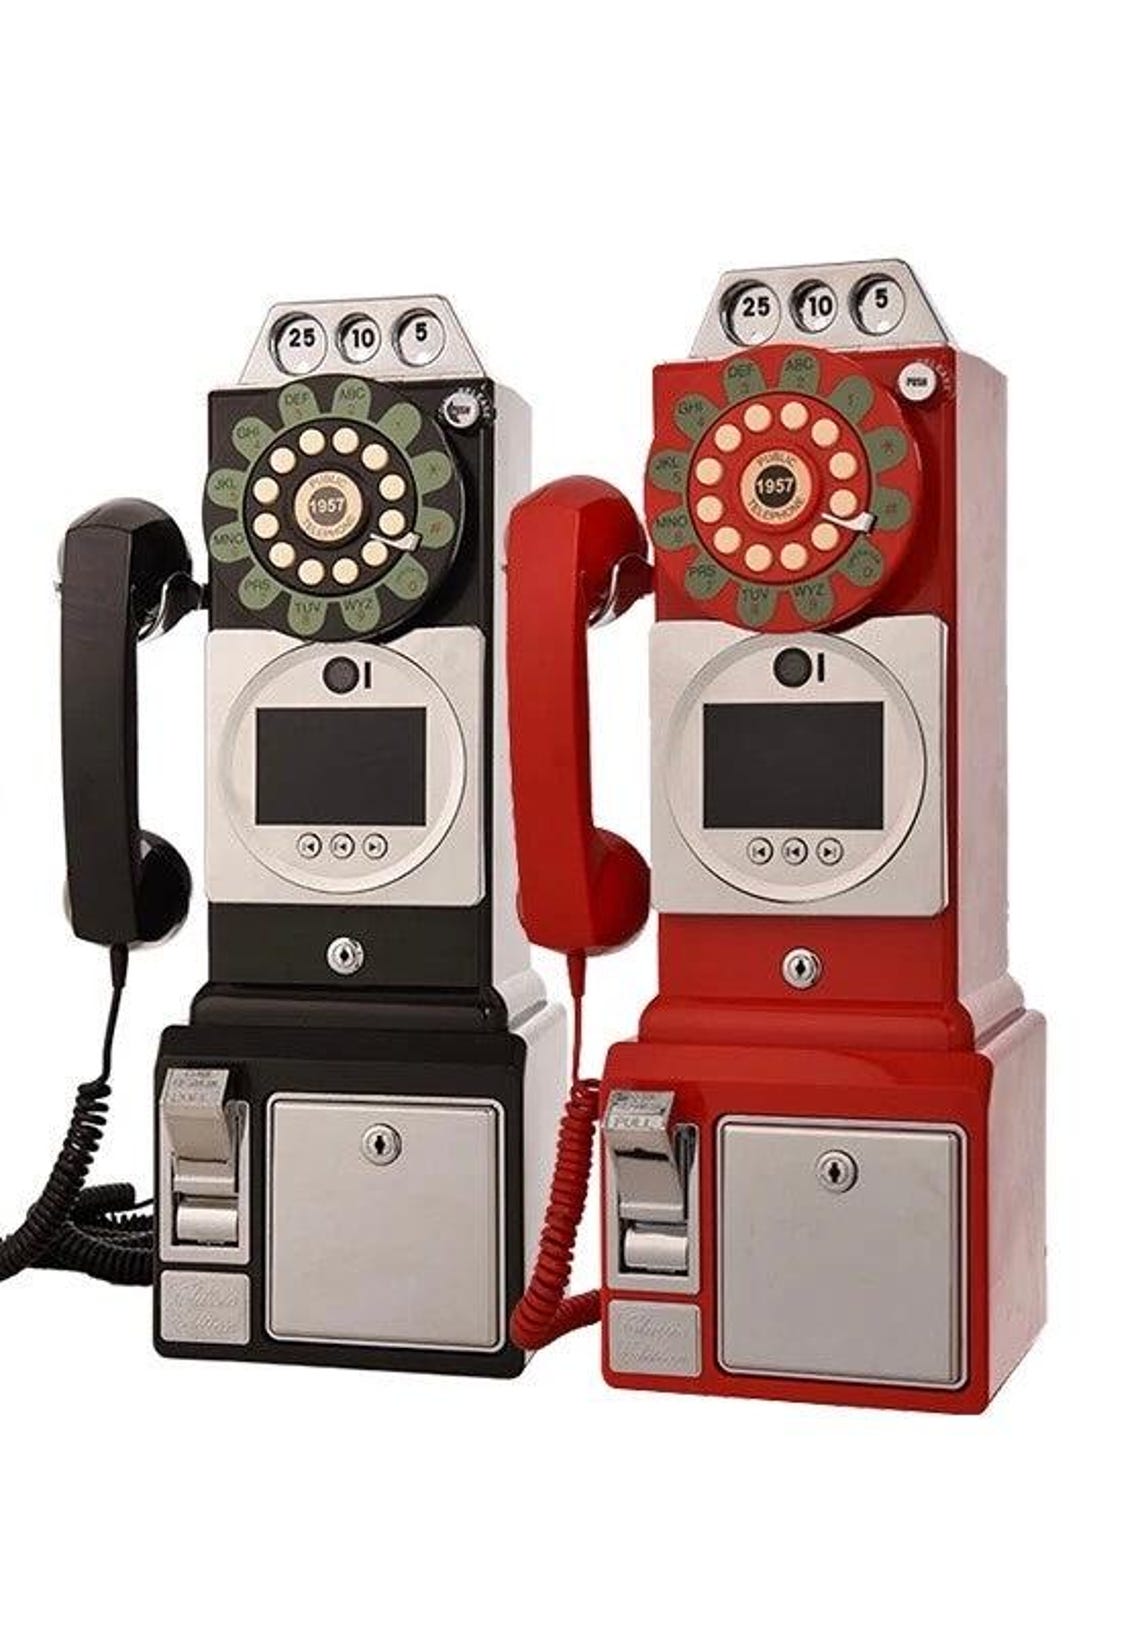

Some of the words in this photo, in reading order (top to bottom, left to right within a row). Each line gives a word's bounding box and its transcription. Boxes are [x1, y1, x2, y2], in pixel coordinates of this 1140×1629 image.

[743, 297, 770, 317] 25
[808, 295, 832, 316] 10
[875, 288, 888, 308] 5
[289, 328, 316, 348] 25
[352, 328, 375, 348] 10
[415, 322, 427, 342] 5
[906, 376, 928, 388] PUSH
[755, 451, 797, 468] PUBLIC
[756, 477, 795, 495] 1957
[309, 496, 345, 514] 1957
